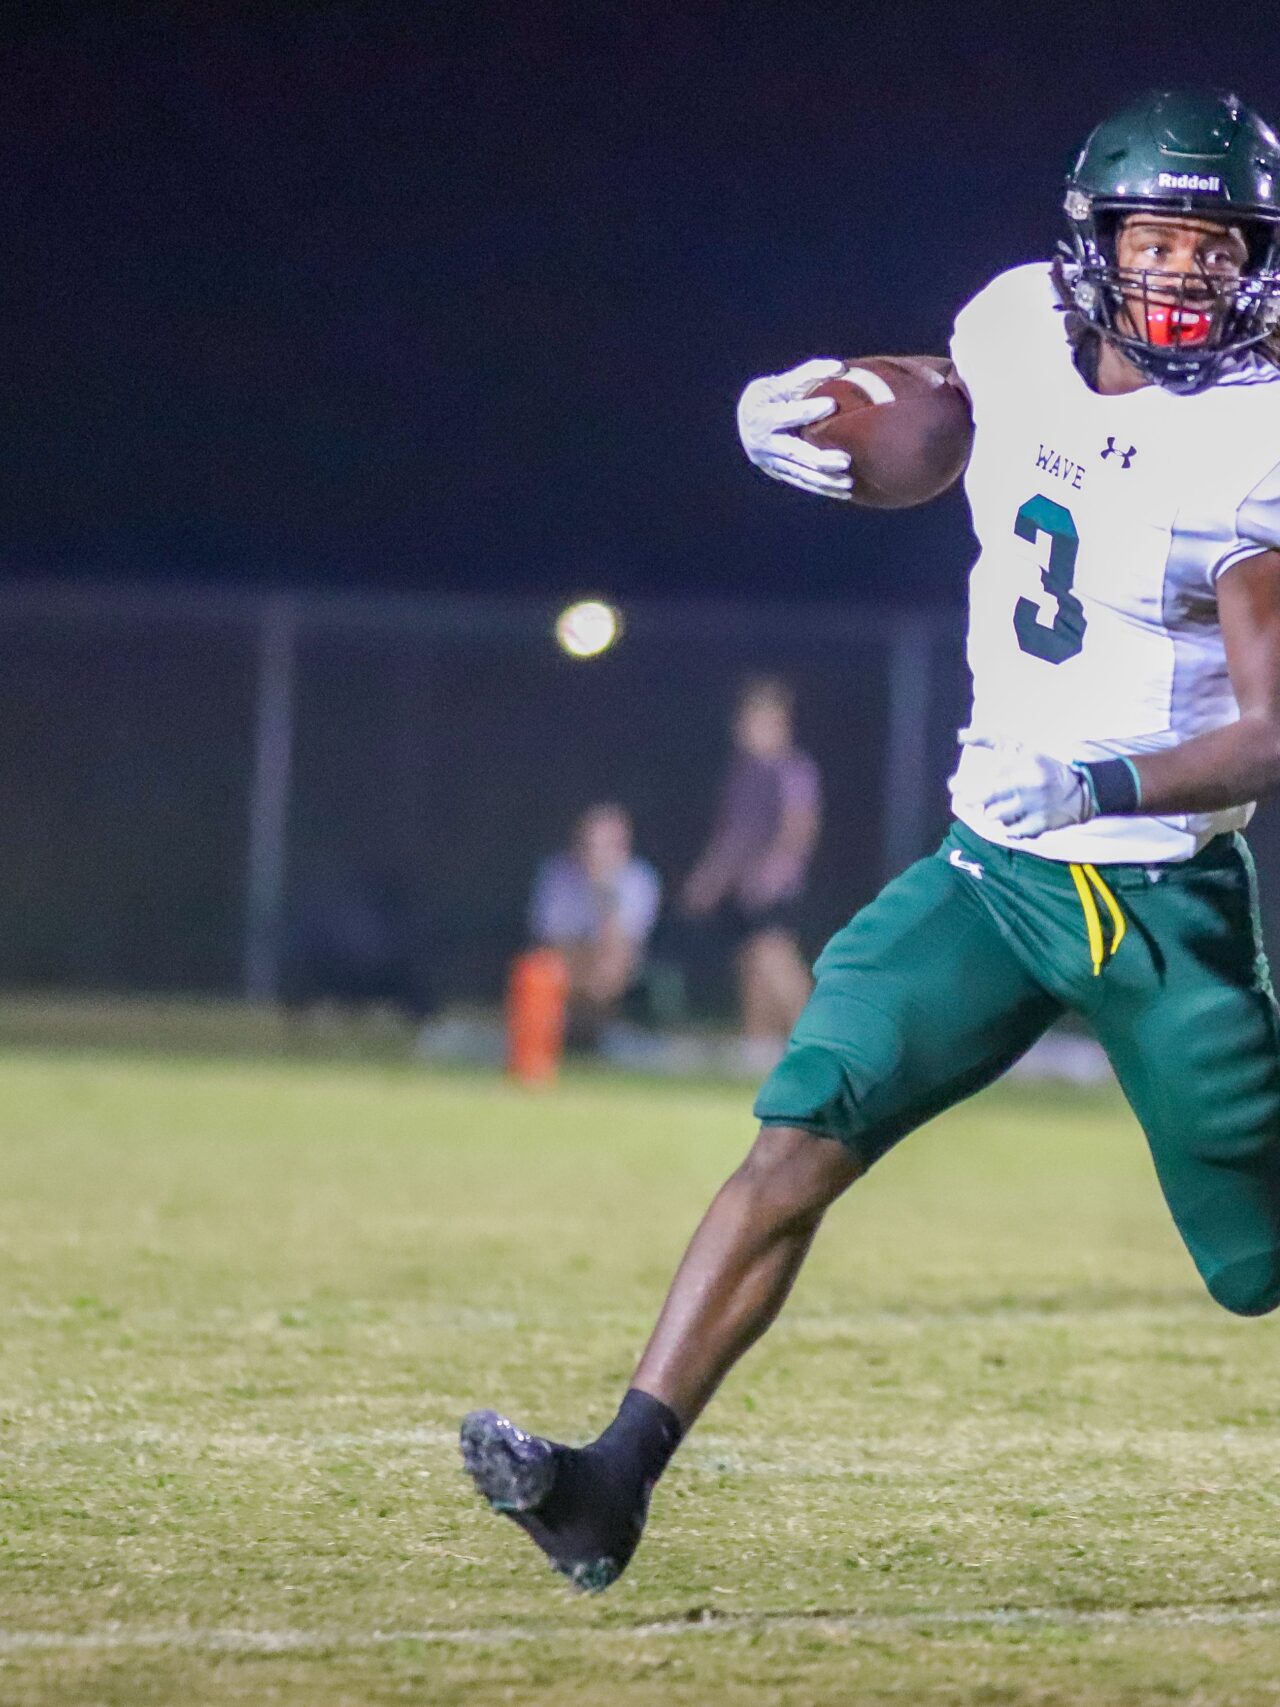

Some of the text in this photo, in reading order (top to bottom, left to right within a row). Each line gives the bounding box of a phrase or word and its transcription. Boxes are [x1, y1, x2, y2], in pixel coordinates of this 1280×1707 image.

[1158, 172, 1220, 192] Riddell
[1035, 444, 1086, 490] WAVE
[1012, 493, 1088, 666] 3
